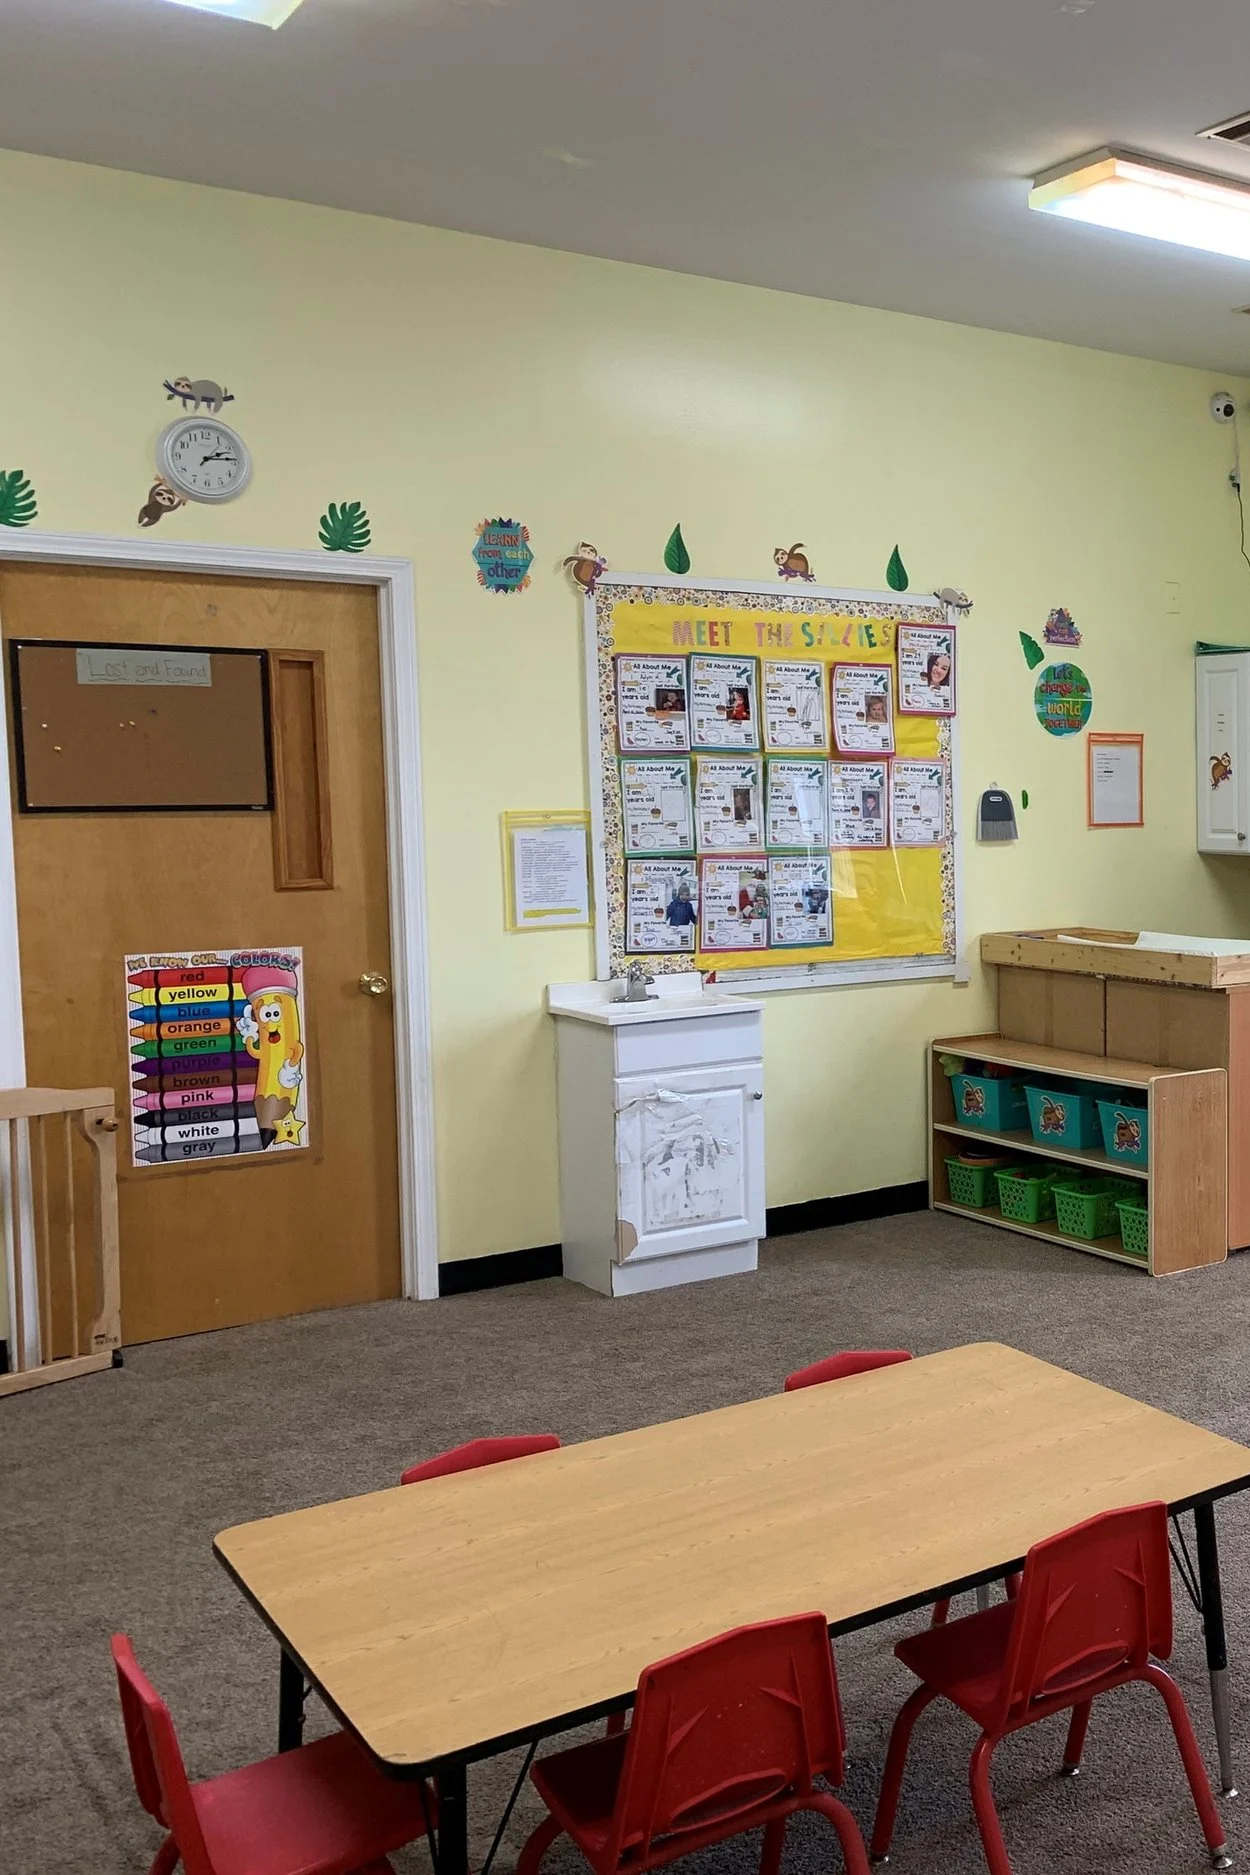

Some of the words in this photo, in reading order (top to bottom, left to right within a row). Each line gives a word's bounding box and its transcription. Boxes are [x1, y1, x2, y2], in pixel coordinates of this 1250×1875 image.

[189, 433, 197, 442] 11
[201, 431, 210, 440] 12
[180, 441, 189, 449] 10
[488, 561, 520, 578] other
[672, 621, 732, 646] MEET
[754, 622, 793, 647] THE
[802, 622, 891, 648] SILLIES
[87, 655, 127, 677] Lost
[136, 663, 159, 676] and
[164, 660, 207, 677] Found
[1047, 701, 1081, 716] world
[150, 957, 189, 968] KNOW
[230, 950, 301, 970] COLORS!
[180, 970, 205, 982] red
[169, 988, 217, 1001] yellow
[177, 1006, 210, 1018] blue
[168, 1021, 221, 1034] orange
[174, 1039, 217, 1051] green
[172, 1057, 220, 1071] purple
[173, 1075, 220, 1087] brown
[181, 1090, 214, 1104] pink
[178, 1109, 218, 1121] black
[178, 1126, 219, 1138] white
[182, 1142, 215, 1155] gray
